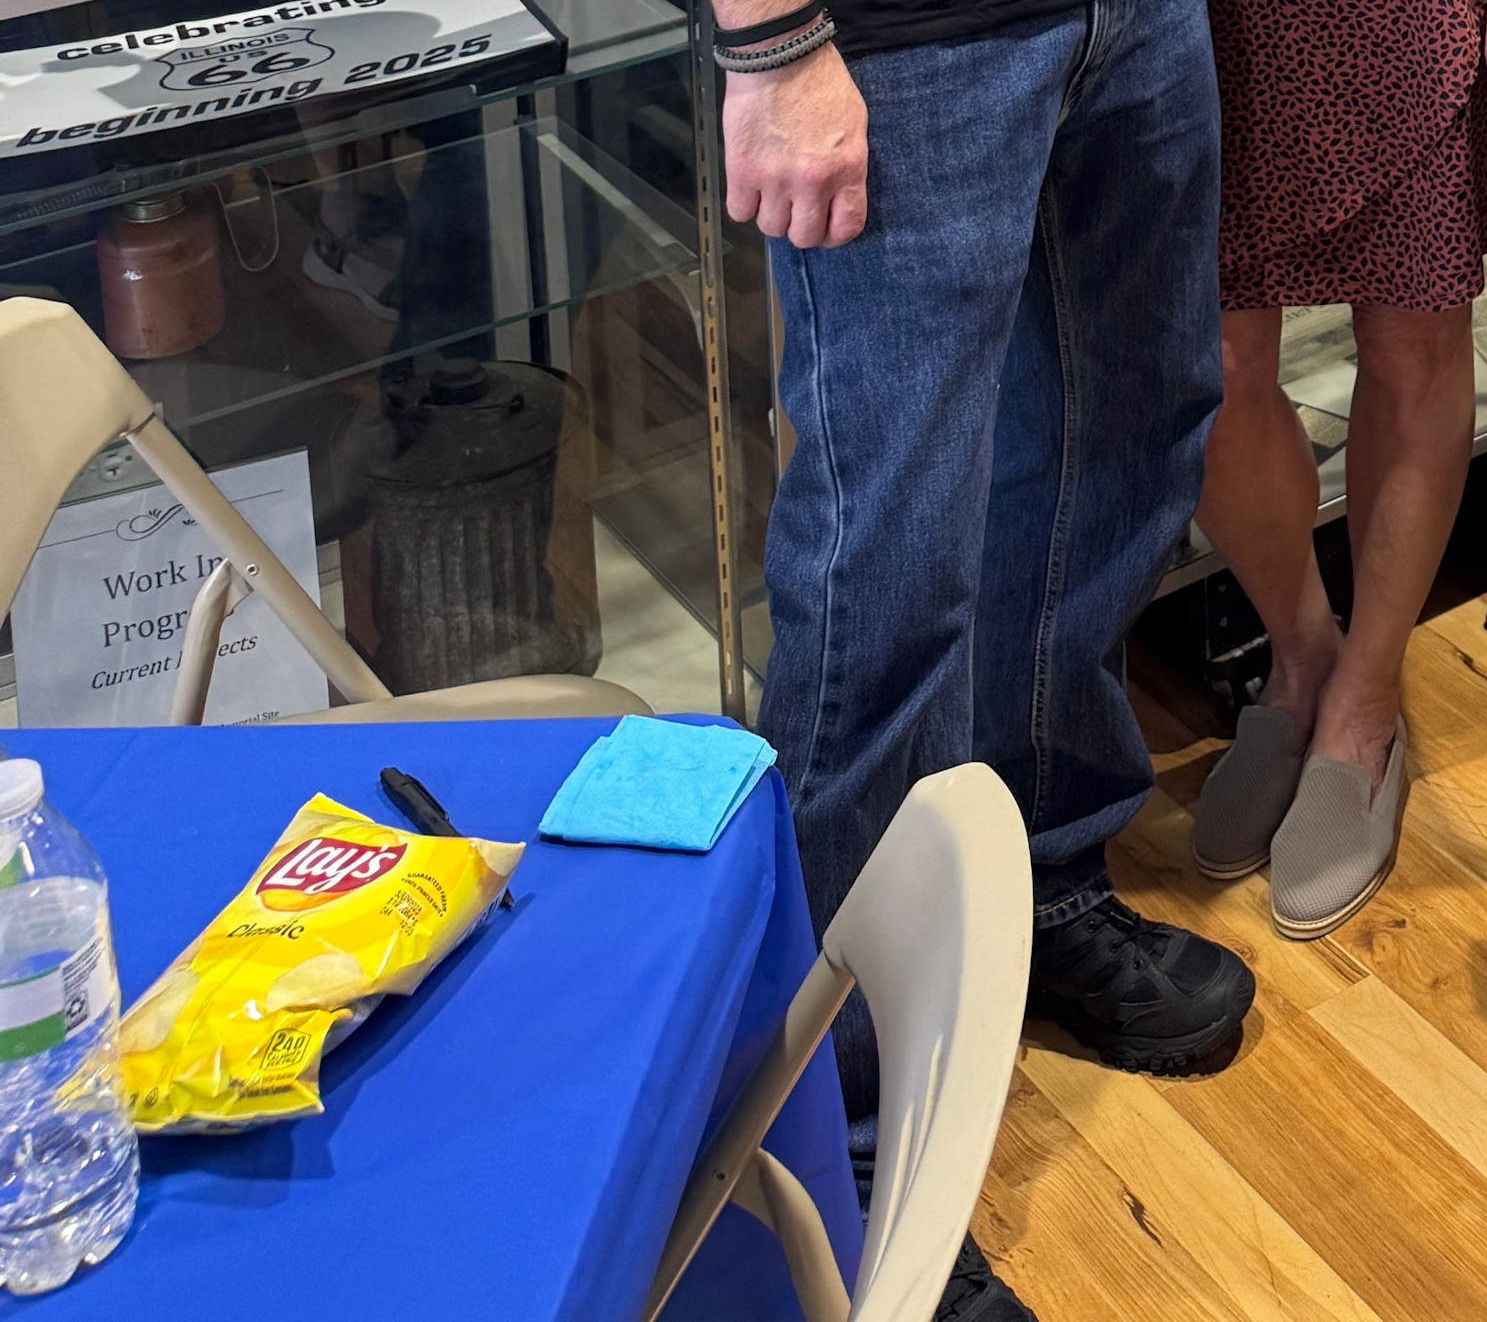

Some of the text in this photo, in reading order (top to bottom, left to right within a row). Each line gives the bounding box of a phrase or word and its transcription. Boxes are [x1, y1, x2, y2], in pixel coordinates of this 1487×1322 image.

[180, 32, 290, 62] ILLINOIS
[187, 52, 310, 87] 66
[15, 35, 494, 148] beginning 2025
[103, 560, 188, 600] Work
[103, 607, 188, 648] Progr
[91, 659, 172, 690] Current
[265, 839, 398, 895] Lay's
